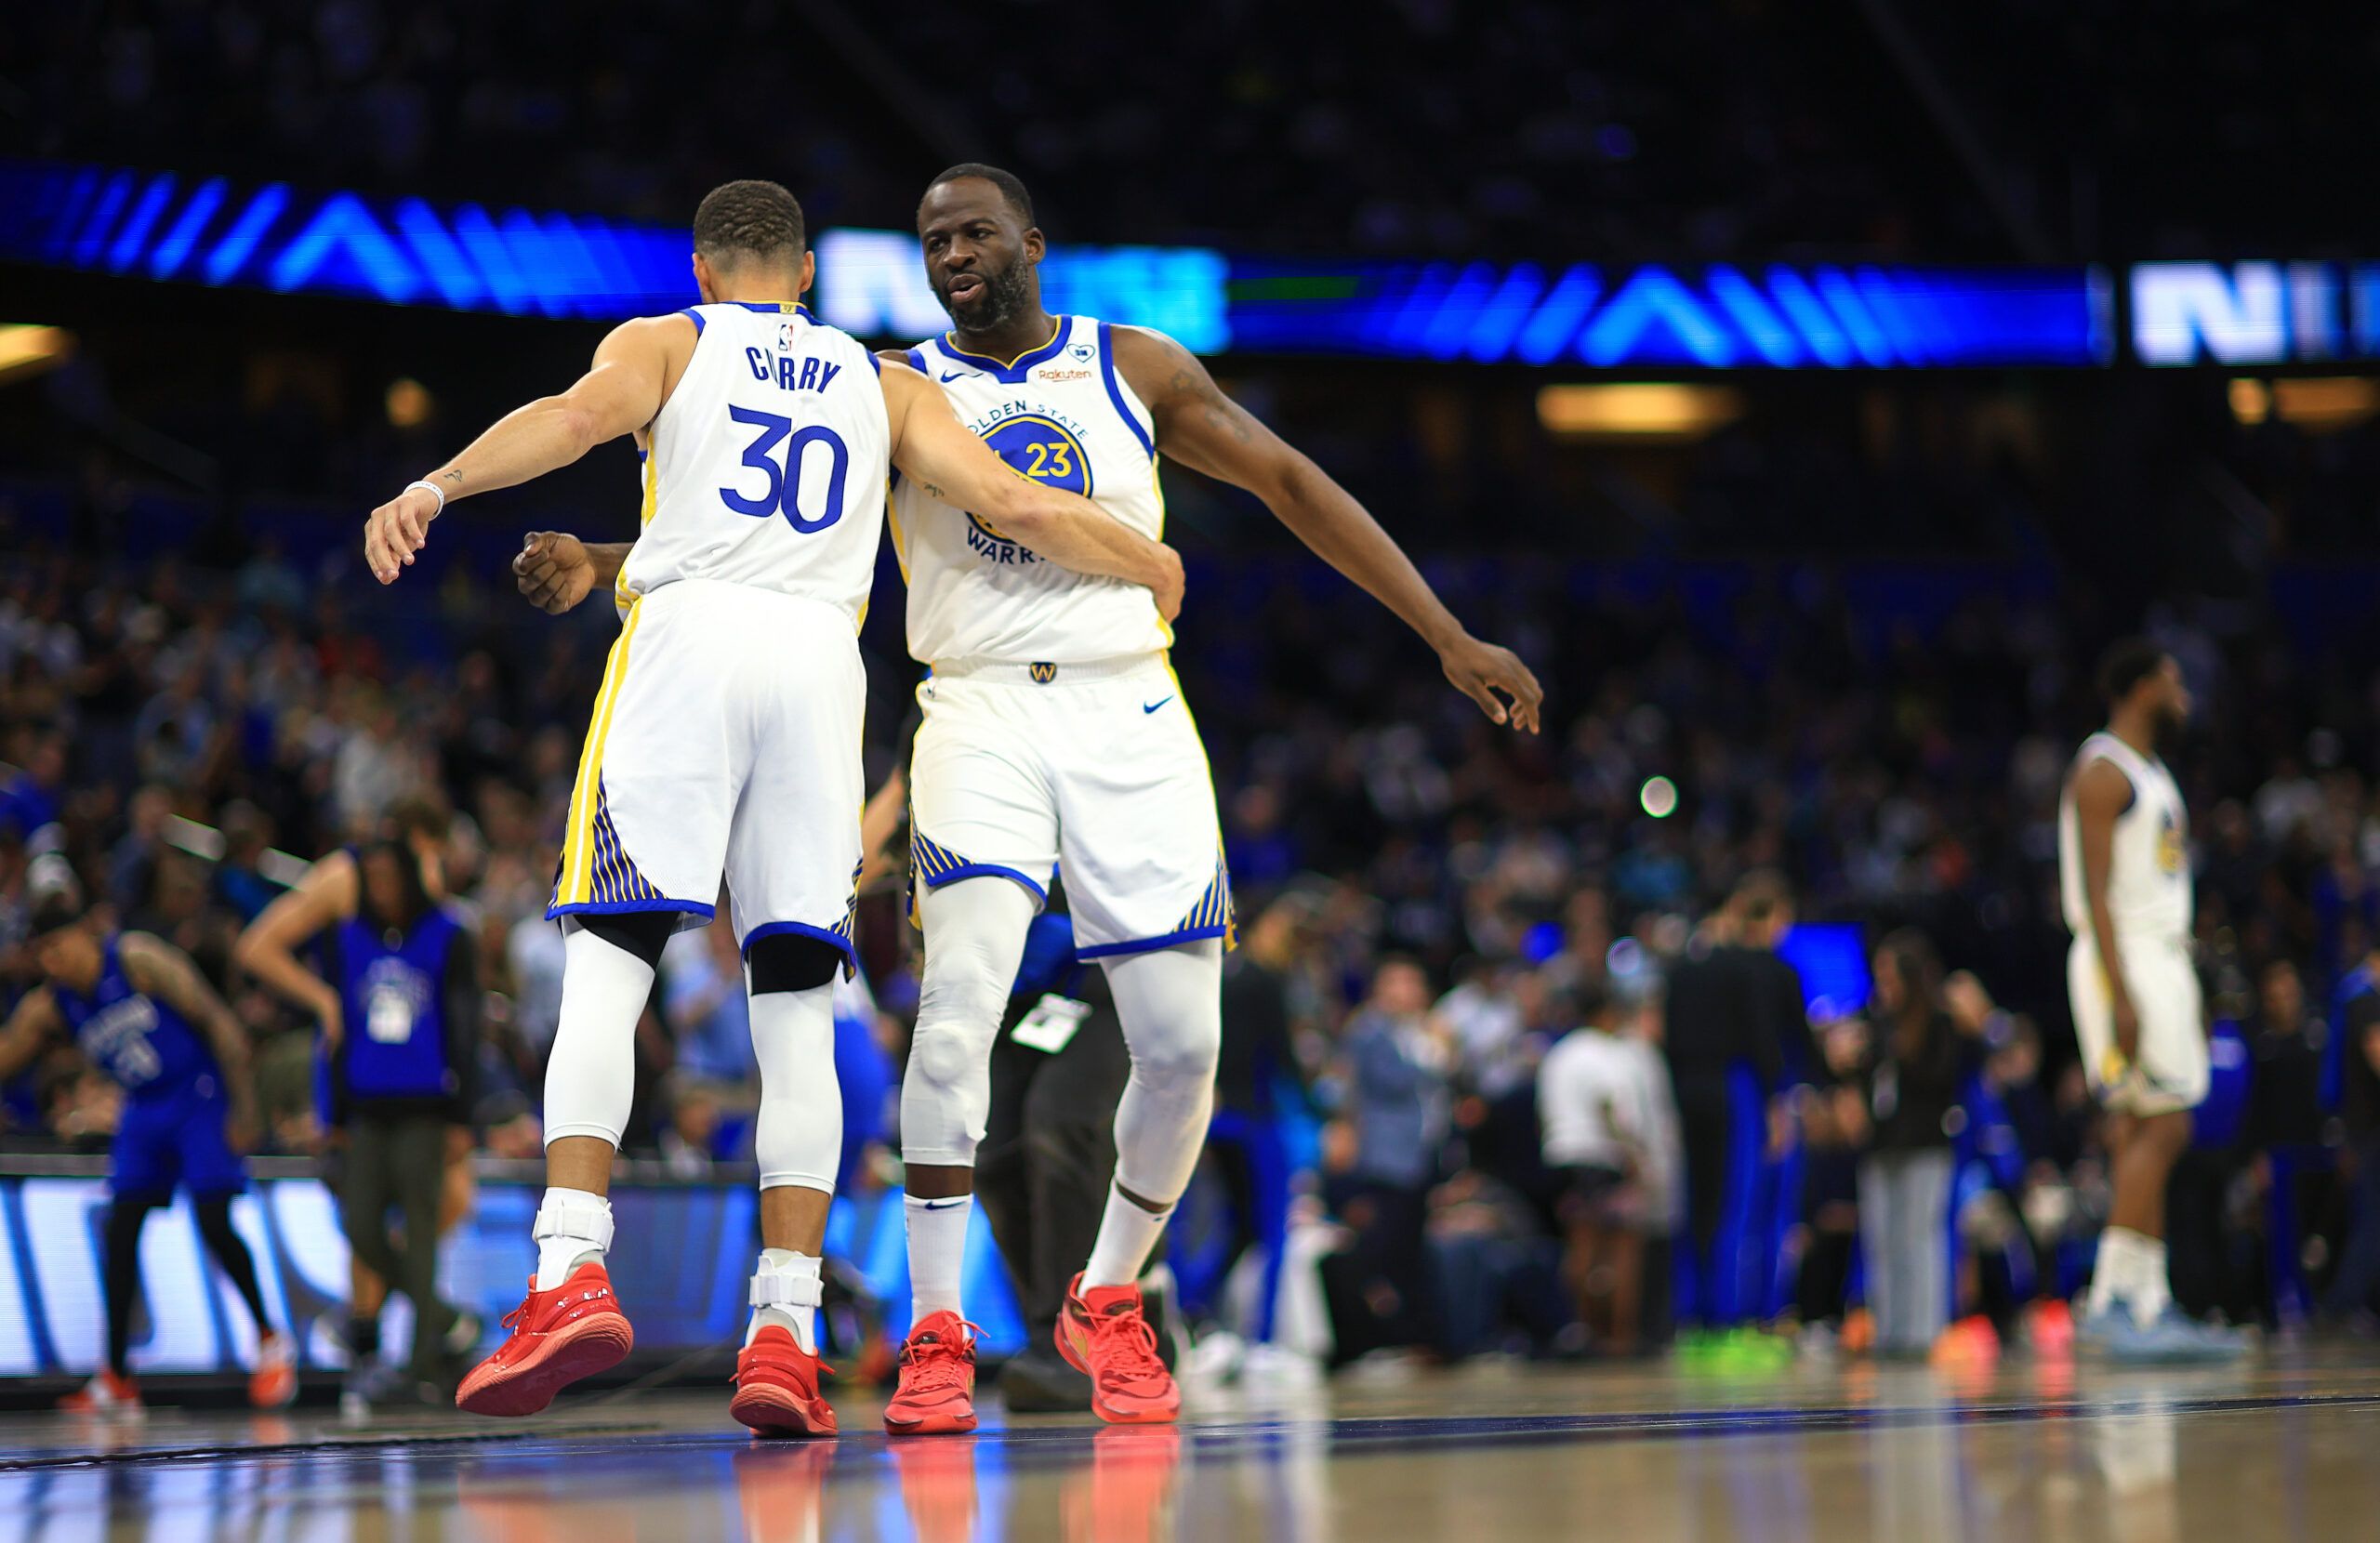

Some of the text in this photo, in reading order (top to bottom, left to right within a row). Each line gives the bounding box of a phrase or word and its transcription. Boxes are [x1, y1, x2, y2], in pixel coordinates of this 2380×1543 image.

[1038, 368, 1091, 380] Rakuten
[1038, 403, 1089, 440] STATE
[719, 403, 848, 534] 30
[1025, 442, 1072, 478] 23
[1030, 664, 1056, 681] W
